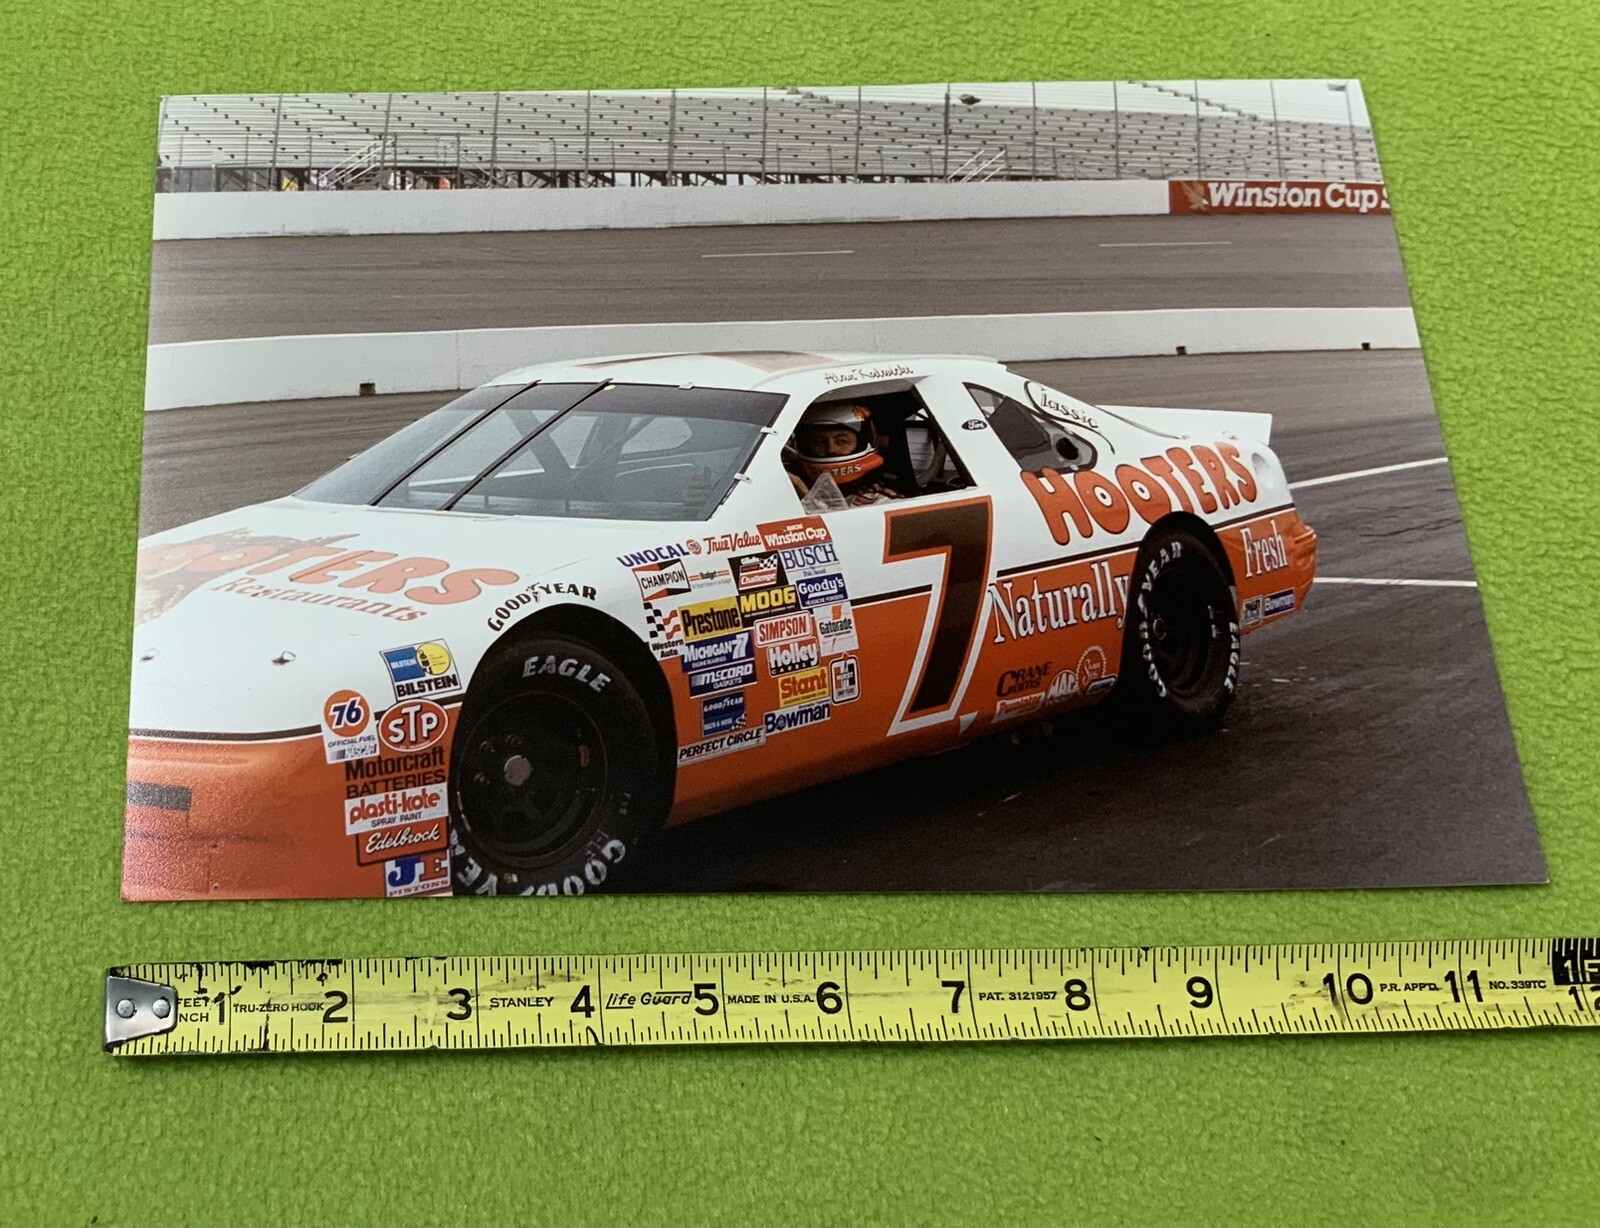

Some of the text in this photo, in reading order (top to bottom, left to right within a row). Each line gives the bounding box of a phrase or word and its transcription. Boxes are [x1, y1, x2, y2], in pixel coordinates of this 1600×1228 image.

[1208, 182, 1320, 208] Winston
[1325, 182, 1379, 213] Cup
[1020, 441, 1258, 546] HOOTERS
[764, 527, 828, 547] Winston Cup
[1240, 519, 1289, 578] Fresh
[616, 543, 691, 568] UNOCAL
[780, 543, 839, 570] BUSCH
[640, 569, 687, 590] CHAMPION
[740, 573, 776, 585] Challenge
[799, 577, 845, 596] Goody's
[211, 576, 428, 622] Restaurants
[487, 582, 598, 632] GOODYEAR
[740, 586, 797, 613] MOOG
[987, 560, 1131, 644] Naturally
[681, 607, 741, 637] Prestone
[760, 615, 807, 642] SIMPSON
[819, 618, 853, 635] Gatorade
[882, 494, 993, 737] 7
[652, 640, 684, 651] Western
[660, 649, 679, 659] Auto
[768, 643, 819, 669] Holley
[396, 674, 459, 698] BILSTEIN
[522, 655, 611, 692] EAGLE
[713, 677, 743, 690] GASKETS
[780, 669, 828, 699] Stant
[331, 699, 363, 727] 76
[388, 704, 438, 743] STP
[764, 703, 831, 733] Bowman
[328, 735, 376, 748] OFFICIAL FUEL
[679, 740, 727, 760] PERFECT
[726, 727, 763, 747] CIRCLE
[344, 747, 445, 782] Motorcraft
[346, 769, 447, 799] BATTERIES
[350, 788, 441, 825] plasti-kote
[371, 812, 423, 828] SPRAY PAINT
[365, 823, 441, 854] Edelbrock
[389, 881, 449, 897] PISTONS
[233, 991, 349, 1023] TRU-ZERO HOOK 2
[446, 988, 473, 1021] 3
[489, 996, 554, 1008] STANLEY
[570, 984, 595, 1019] 4
[605, 992, 637, 1010] Life
[640, 990, 693, 1006] Guard
[693, 983, 720, 1016] 5
[727, 994, 762, 1004] MADE
[764, 994, 778, 1004] IN
[816, 981, 843, 1014] 6
[941, 980, 966, 1013] 7
[978, 992, 1006, 1001] PAT.
[1008, 991, 1058, 1001] 3121957
[1064, 979, 1091, 1011] 8
[1186, 976, 1213, 1008] 9
[1322, 972, 1373, 1004] 10
[1444, 970, 1484, 1003] 11
[1489, 980, 1510, 990] NO.
[1511, 979, 1547, 990] 339TC
[177, 1013, 209, 1022] NCH
